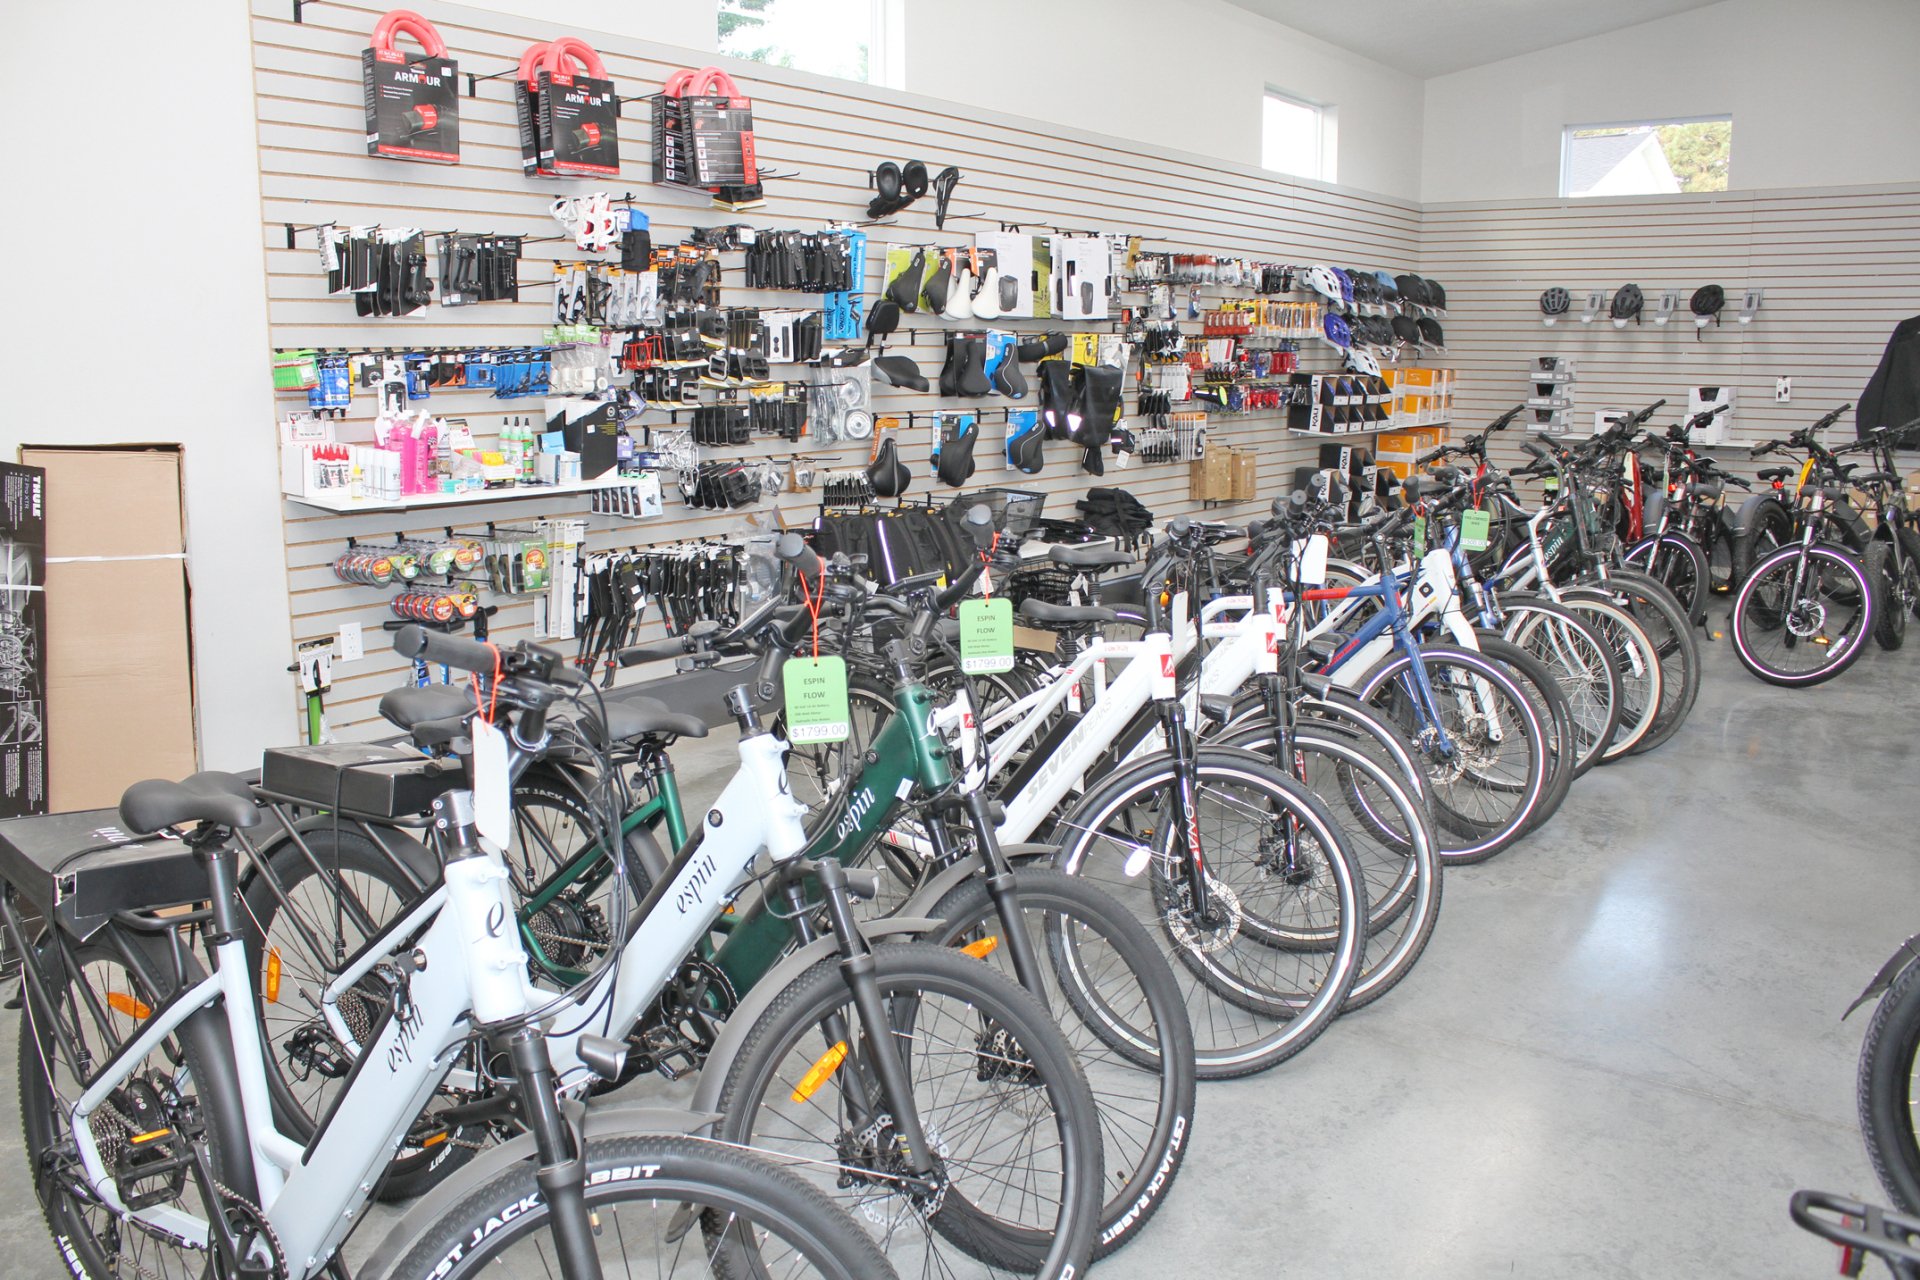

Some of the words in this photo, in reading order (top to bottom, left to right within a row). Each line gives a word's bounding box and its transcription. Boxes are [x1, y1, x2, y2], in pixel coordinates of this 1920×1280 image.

[32, 475, 42, 517] THULE
[803, 677, 825, 686] ESPIN
[803, 691, 826, 699] FLOW
[792, 723, 847, 739] $1799.00
[514, 787, 529, 795] ST
[837, 787, 876, 840] espin
[676, 854, 717, 917] espin
[1170, 1115, 1186, 1152] CST
[1147, 1152, 1175, 1197] JACK
[470, 1191, 540, 1248] JACK
[584, 1164, 661, 1187] BBIT
[1101, 1193, 1151, 1245] RABBIT
